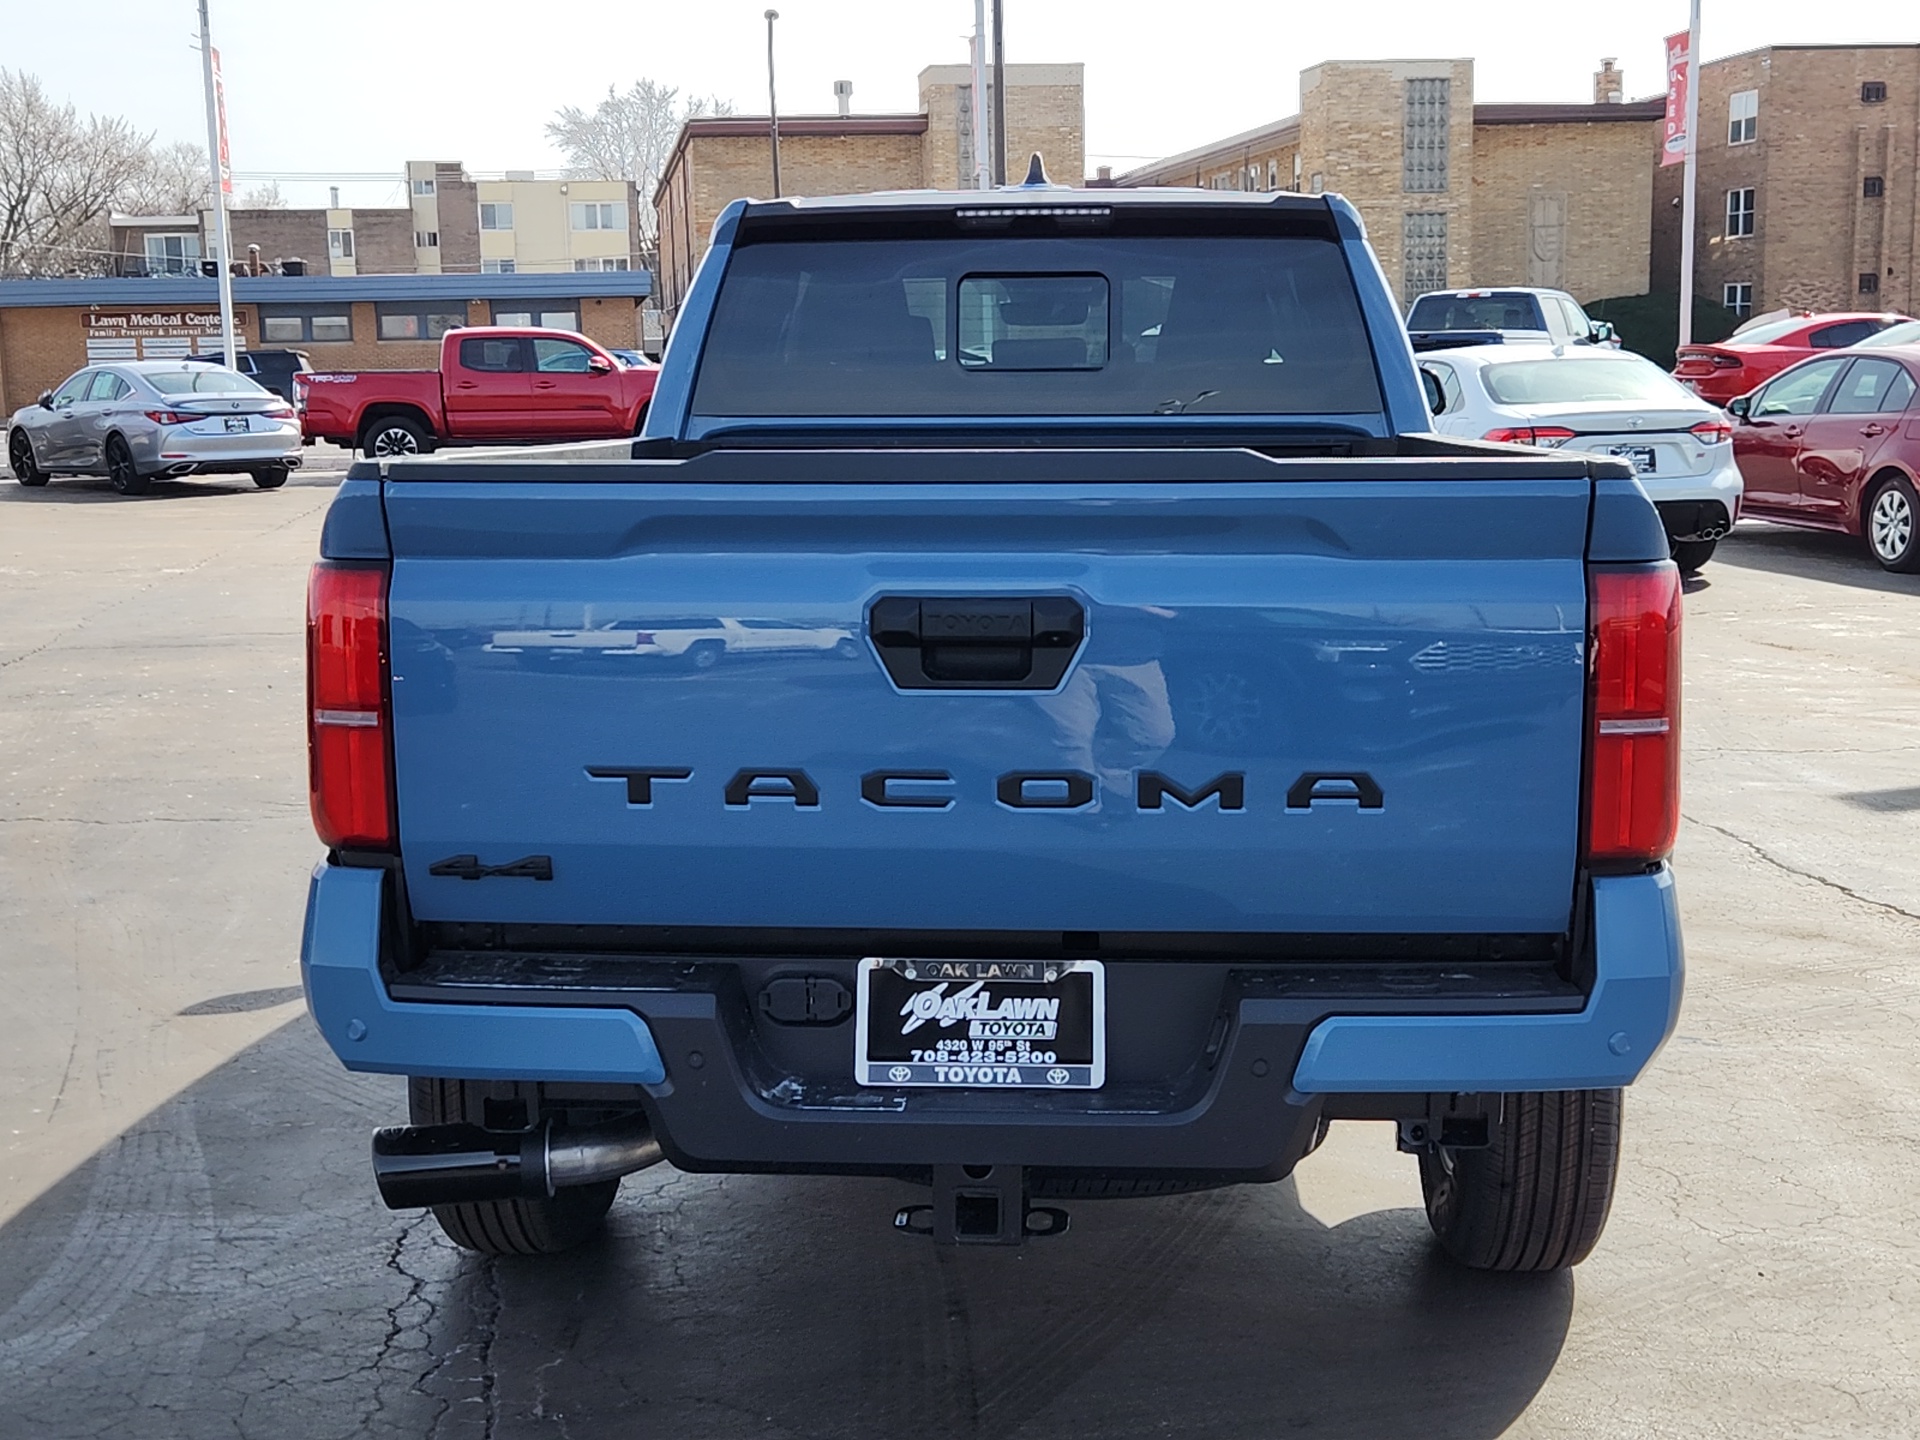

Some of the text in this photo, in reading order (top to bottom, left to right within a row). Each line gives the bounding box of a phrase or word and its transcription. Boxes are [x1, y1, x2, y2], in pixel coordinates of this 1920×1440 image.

[1667, 69, 1678, 135] USED
[90, 314, 127, 328] Lawn
[129, 313, 182, 326] Medical
[185, 313, 222, 327] Cente
[89, 329, 117, 338] Family
[121, 328, 154, 337] Practice
[158, 328, 165, 336] &
[169, 328, 201, 336] Internal
[306, 374, 334, 383] TRD
[927, 614, 1027, 631] TOYOTA
[583, 765, 1385, 813] TACOMA
[925, 963, 1034, 978] OAK LAWN
[979, 1022, 1046, 1036] TOYOTA
[936, 1040, 1031, 1050] 4320 W 95th St
[911, 1050, 1057, 1063] 708-423-5200
[934, 1067, 1022, 1084] TOYOTA
